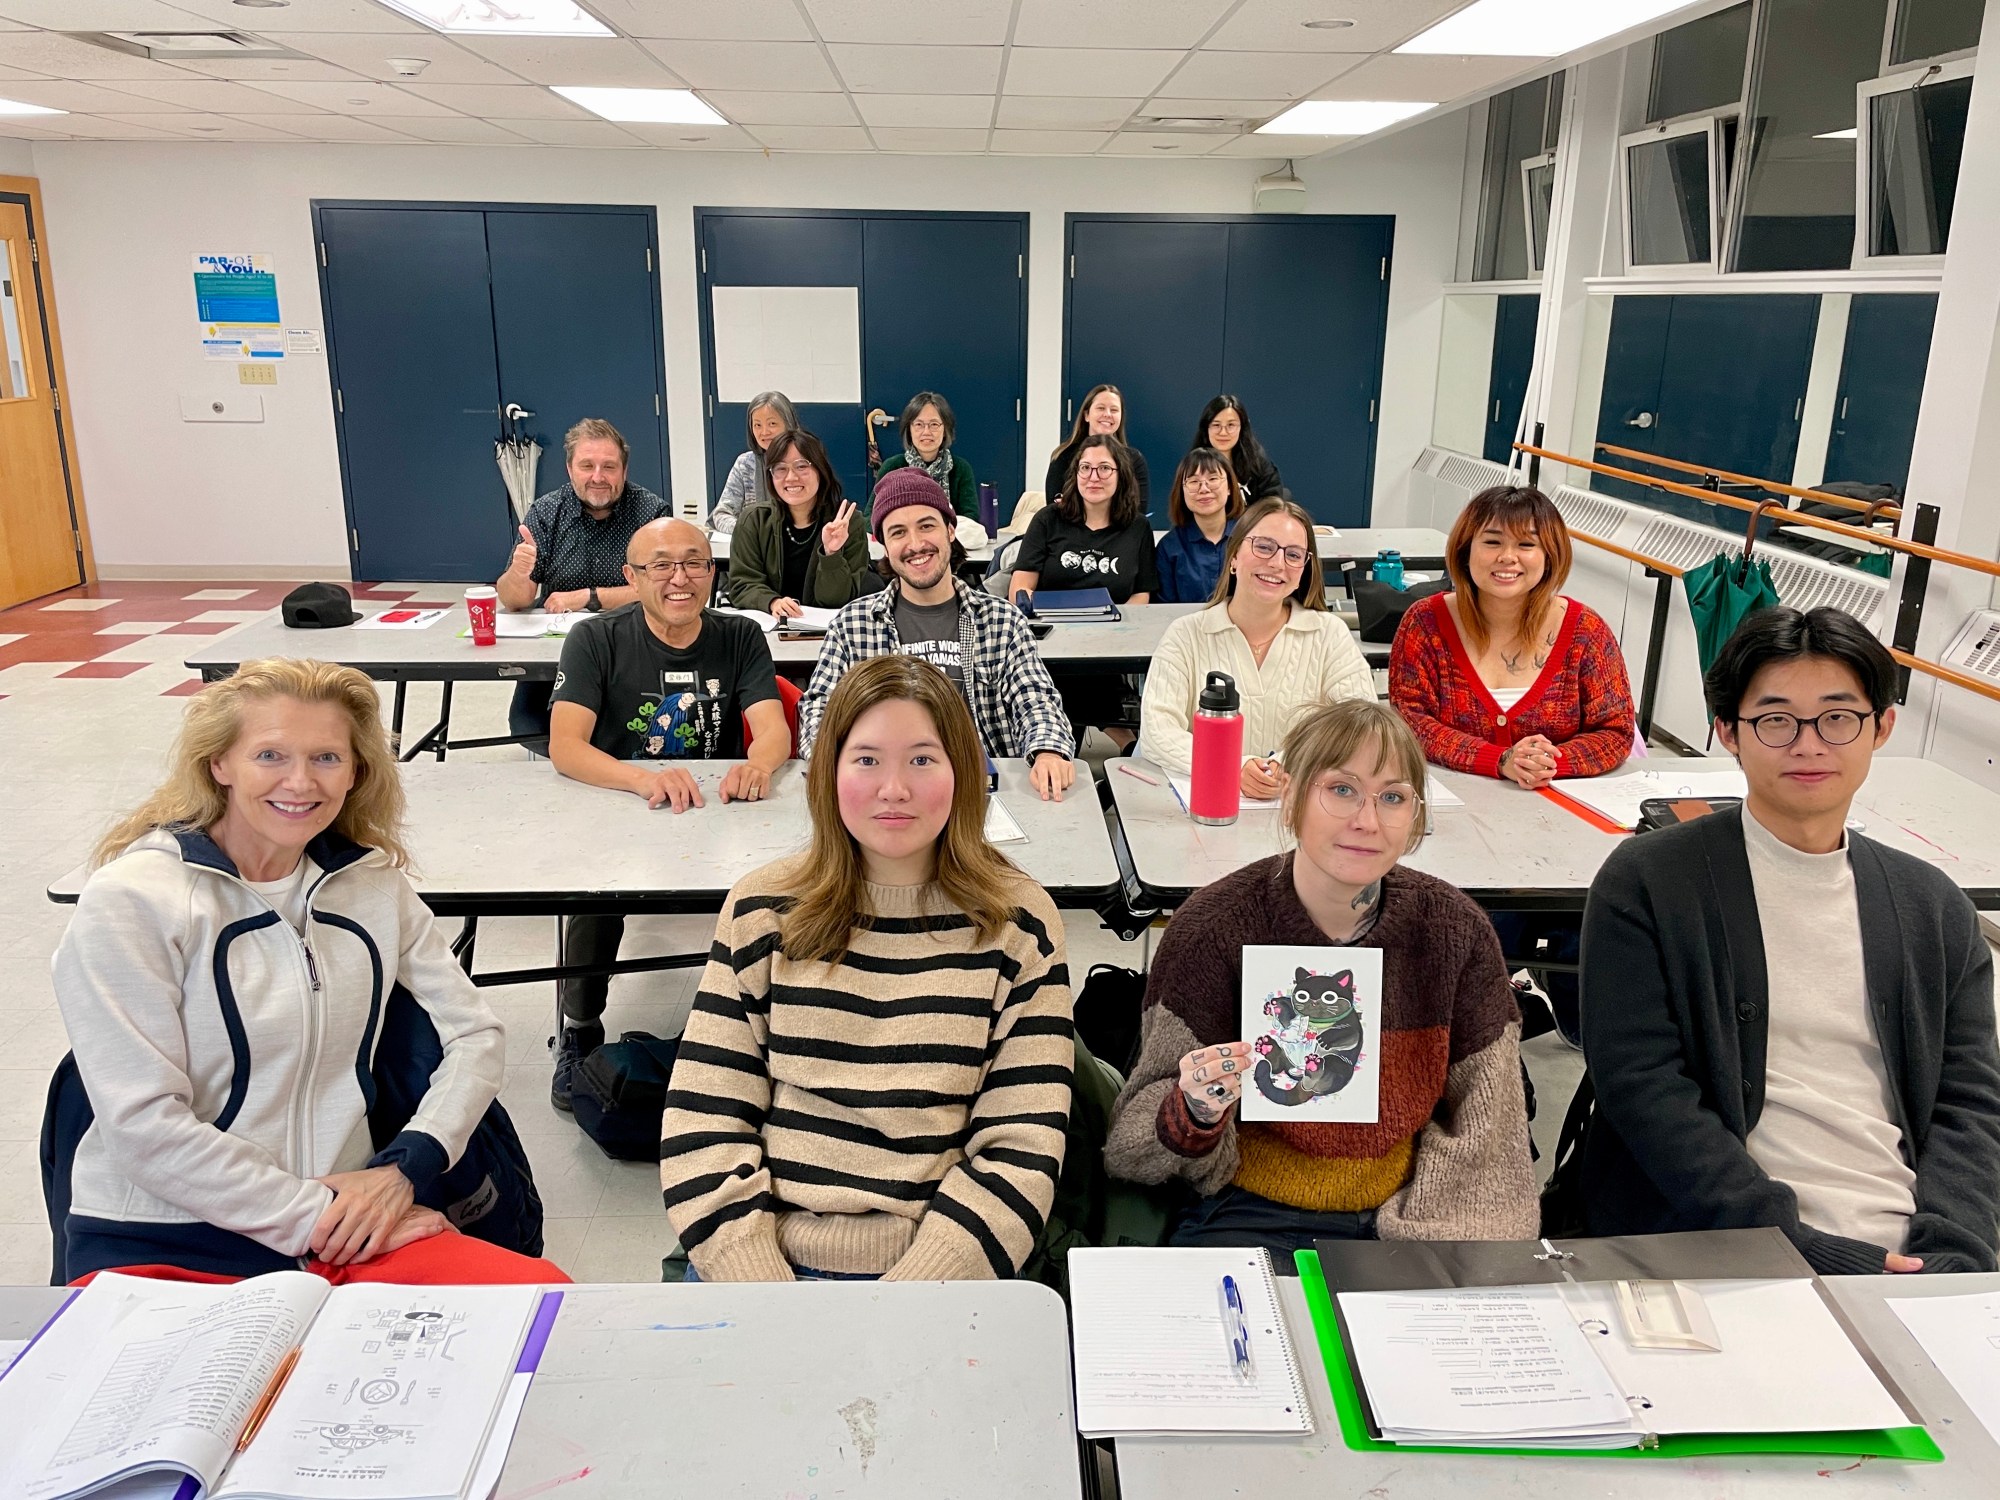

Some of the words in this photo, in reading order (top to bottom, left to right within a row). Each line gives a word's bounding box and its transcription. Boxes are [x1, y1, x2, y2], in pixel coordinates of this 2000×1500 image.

[900, 640, 937, 656] NFINITE
[938, 640, 961, 653] WOR
[928, 652, 961, 666] YANAS
